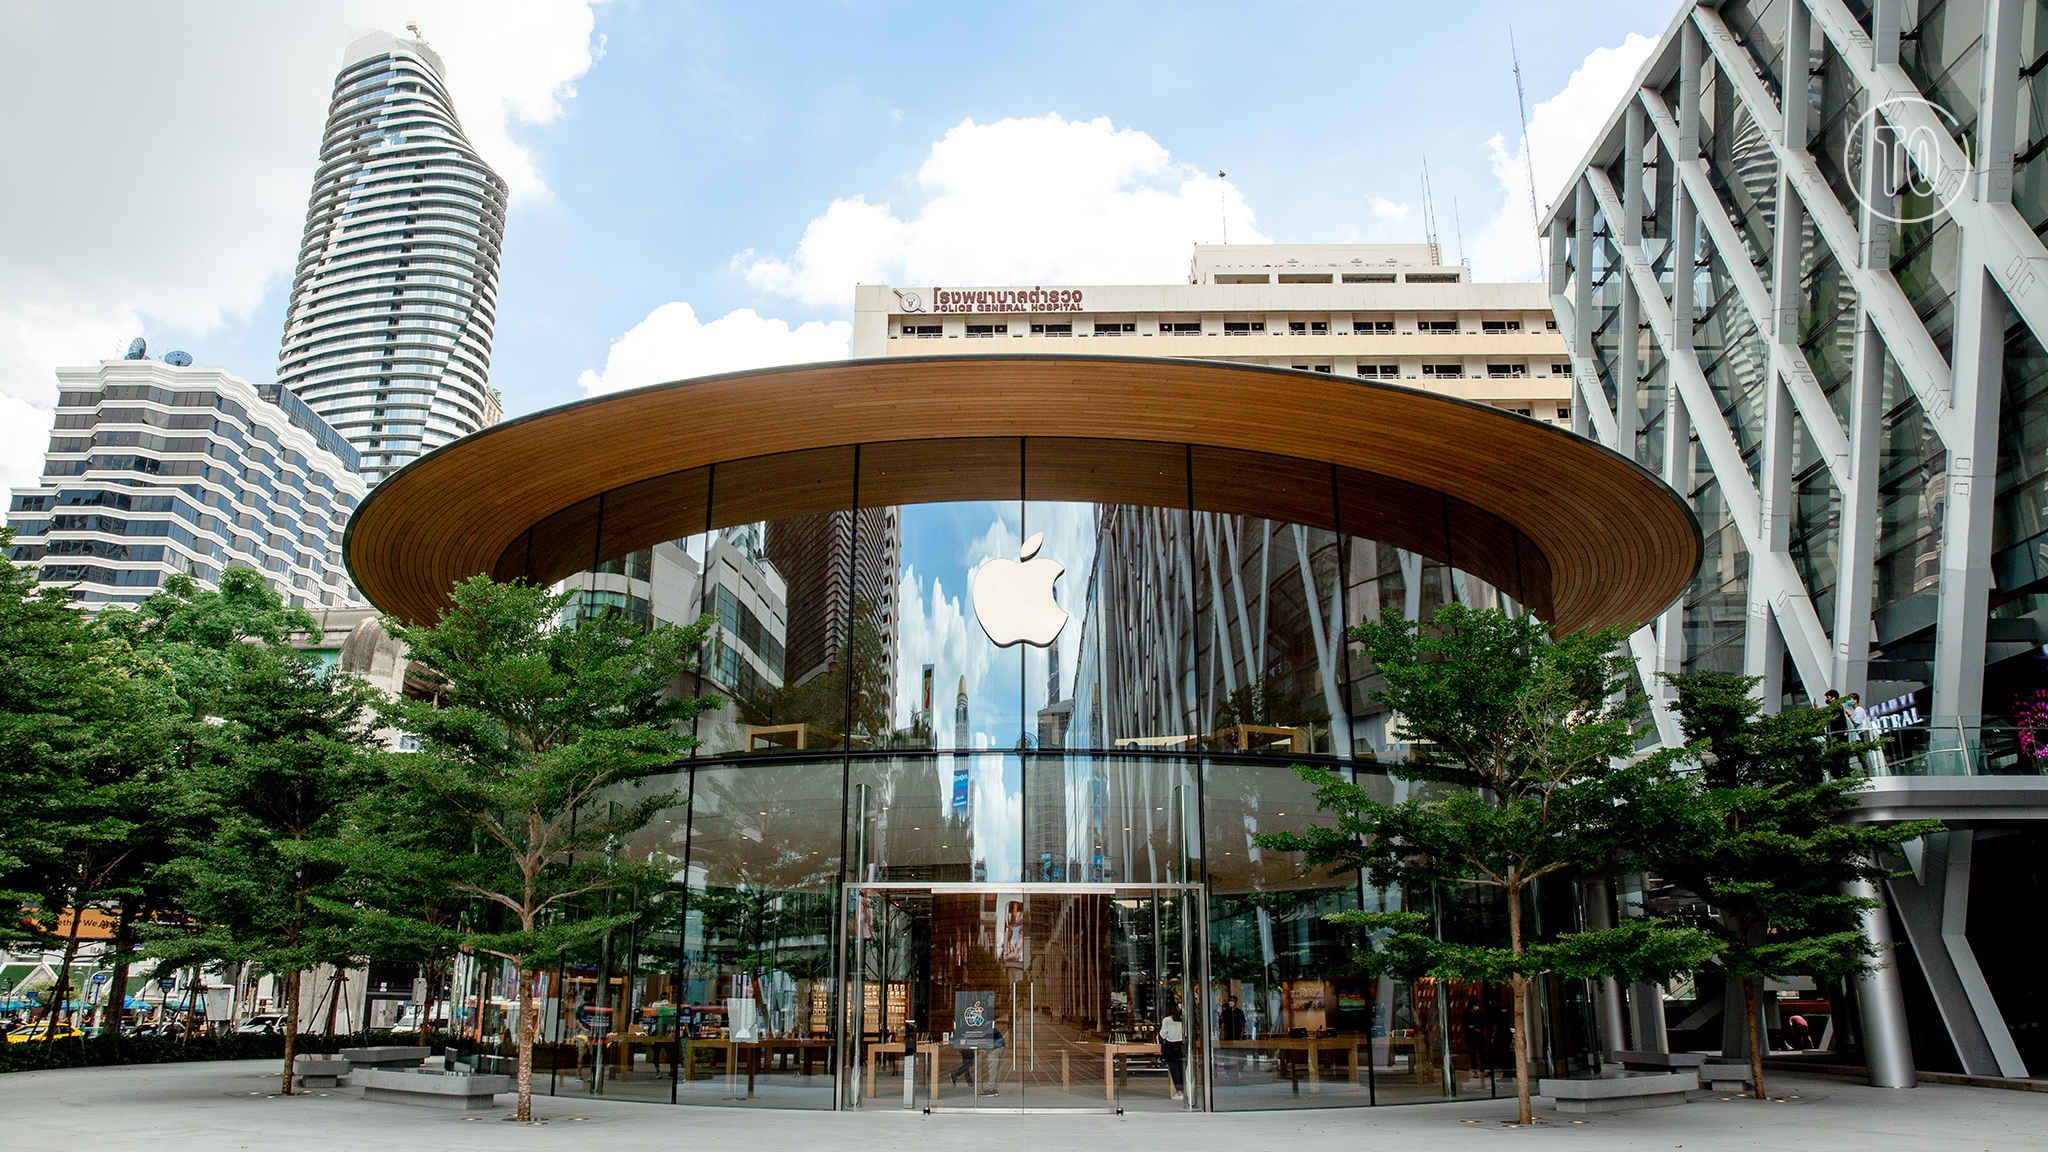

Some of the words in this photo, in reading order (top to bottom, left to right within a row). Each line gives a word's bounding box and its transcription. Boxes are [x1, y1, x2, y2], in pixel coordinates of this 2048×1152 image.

[934, 286, 1083, 304] โรงพยาบาลตำรวจ
[934, 304, 972, 312] POLICE
[977, 303, 1026, 312] GENERAL
[1031, 303, 1083, 312] HOSPITAL
[83, 919, 98, 927] We
